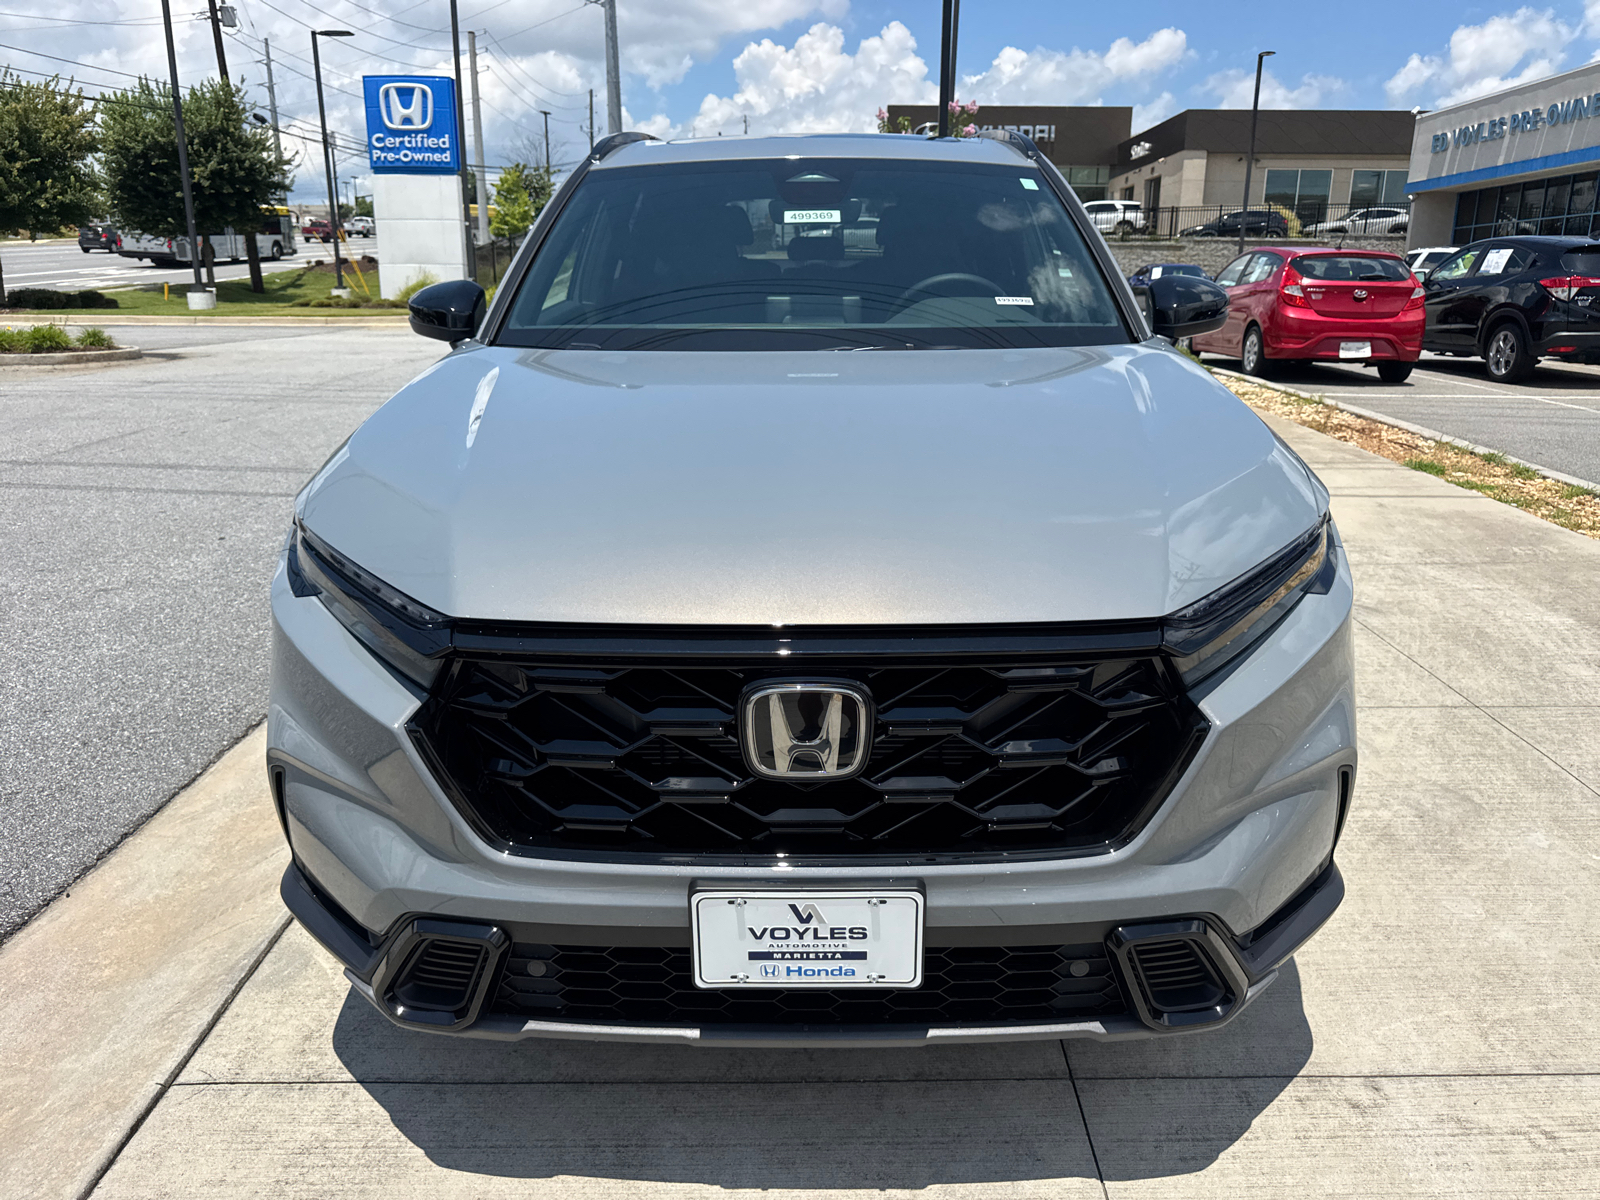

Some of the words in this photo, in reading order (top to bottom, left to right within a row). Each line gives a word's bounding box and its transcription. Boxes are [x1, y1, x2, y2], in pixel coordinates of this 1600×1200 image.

[371, 133, 450, 149] Certified
[1431, 132, 1448, 154] ED
[1453, 116, 1508, 147] VOYLES
[372, 150, 451, 162] Pre-Owned
[790, 212, 833, 220] 499369
[747, 926, 868, 941] VOYLES
[773, 952, 843, 960] MARIETTA
[785, 965, 856, 977] Honda
